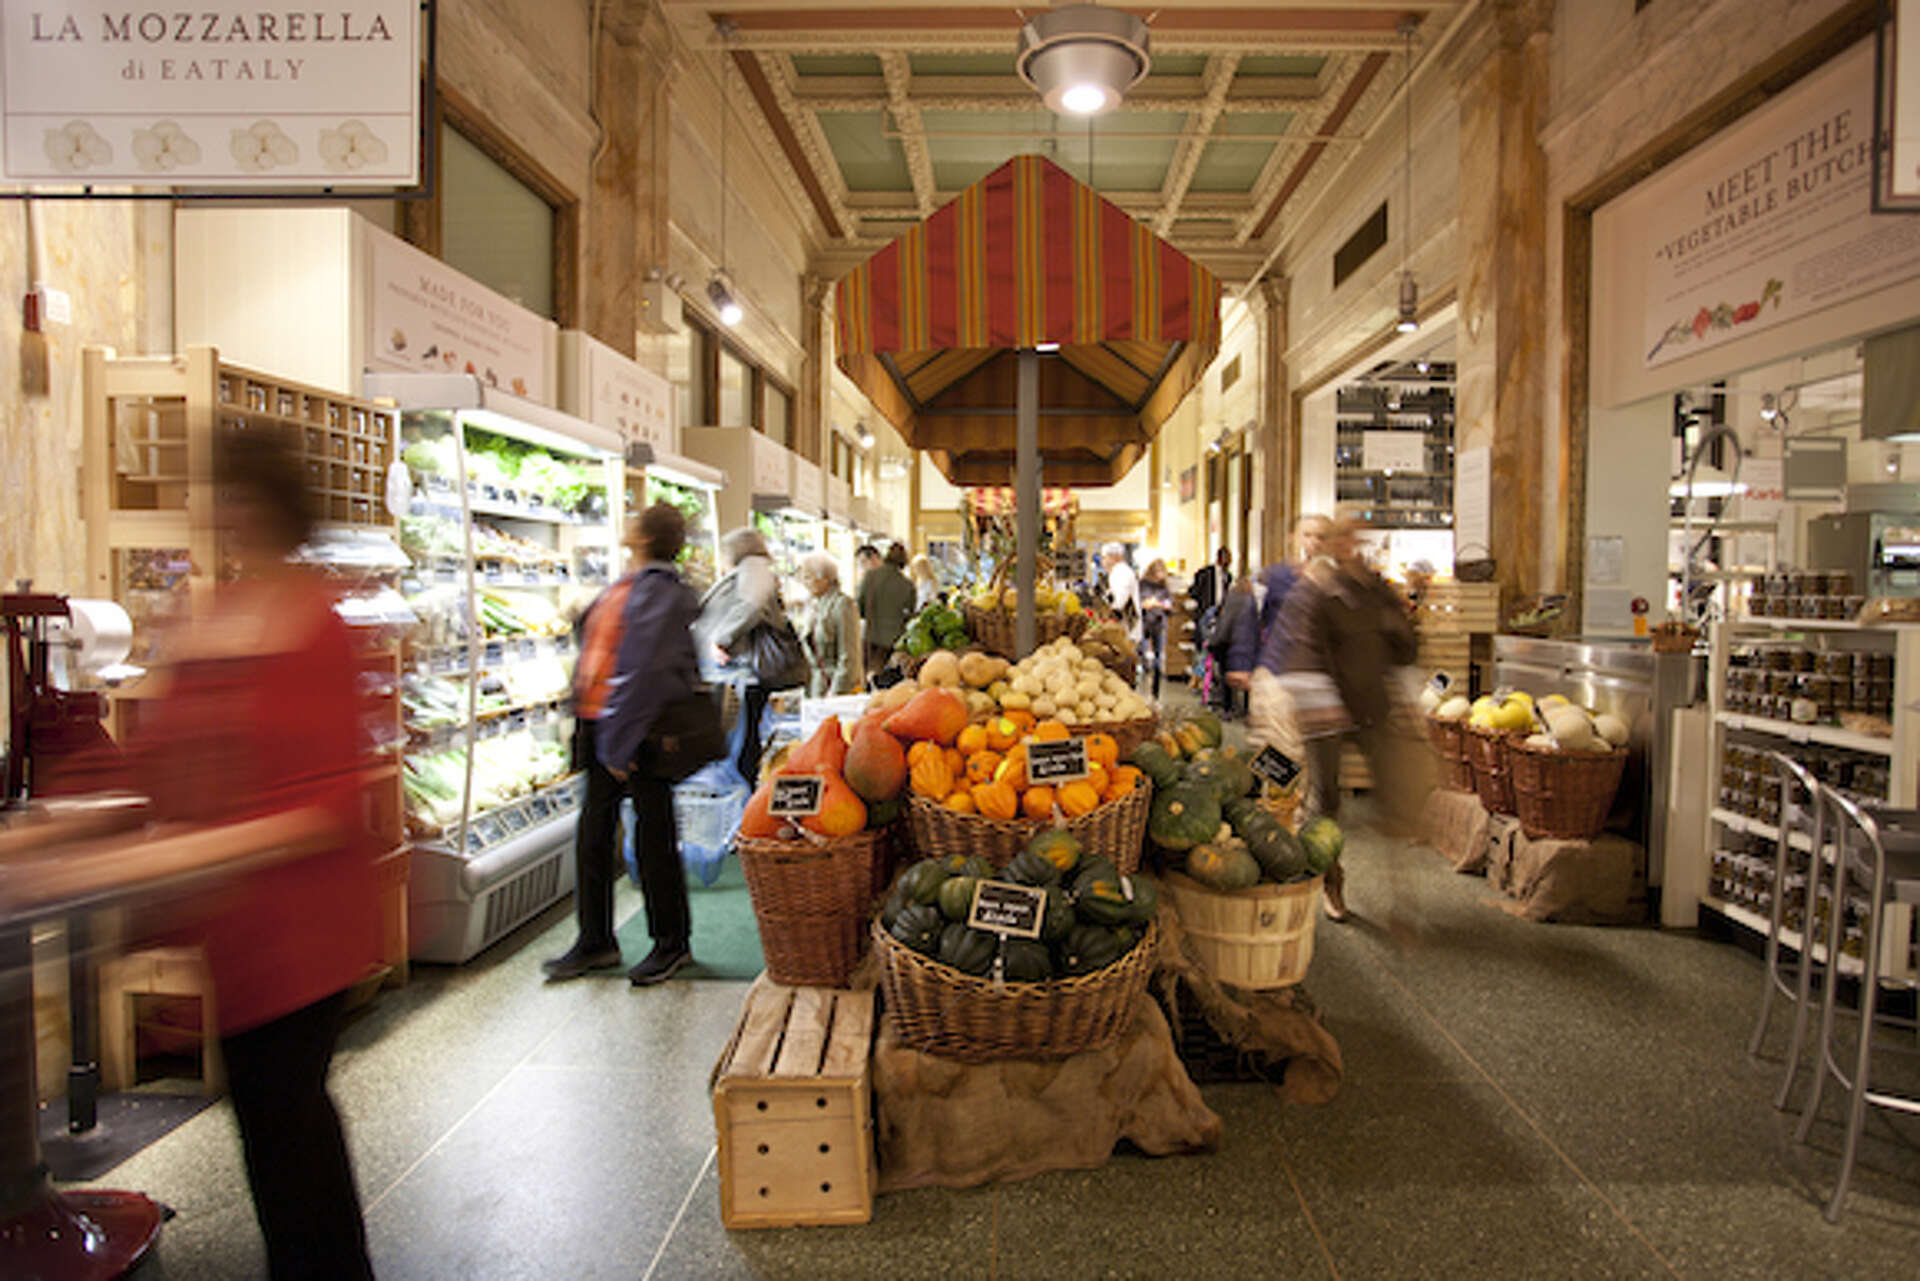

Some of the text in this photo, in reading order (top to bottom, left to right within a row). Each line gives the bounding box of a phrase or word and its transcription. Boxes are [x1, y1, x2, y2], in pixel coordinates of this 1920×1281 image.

[31, 12, 393, 43] LA MOZZARELLA
[121, 59, 305, 80] di EATALY
[1706, 152, 1780, 215] MEET
[1785, 109, 1853, 169] THE
[1787, 134, 1889, 202] BUTCH
